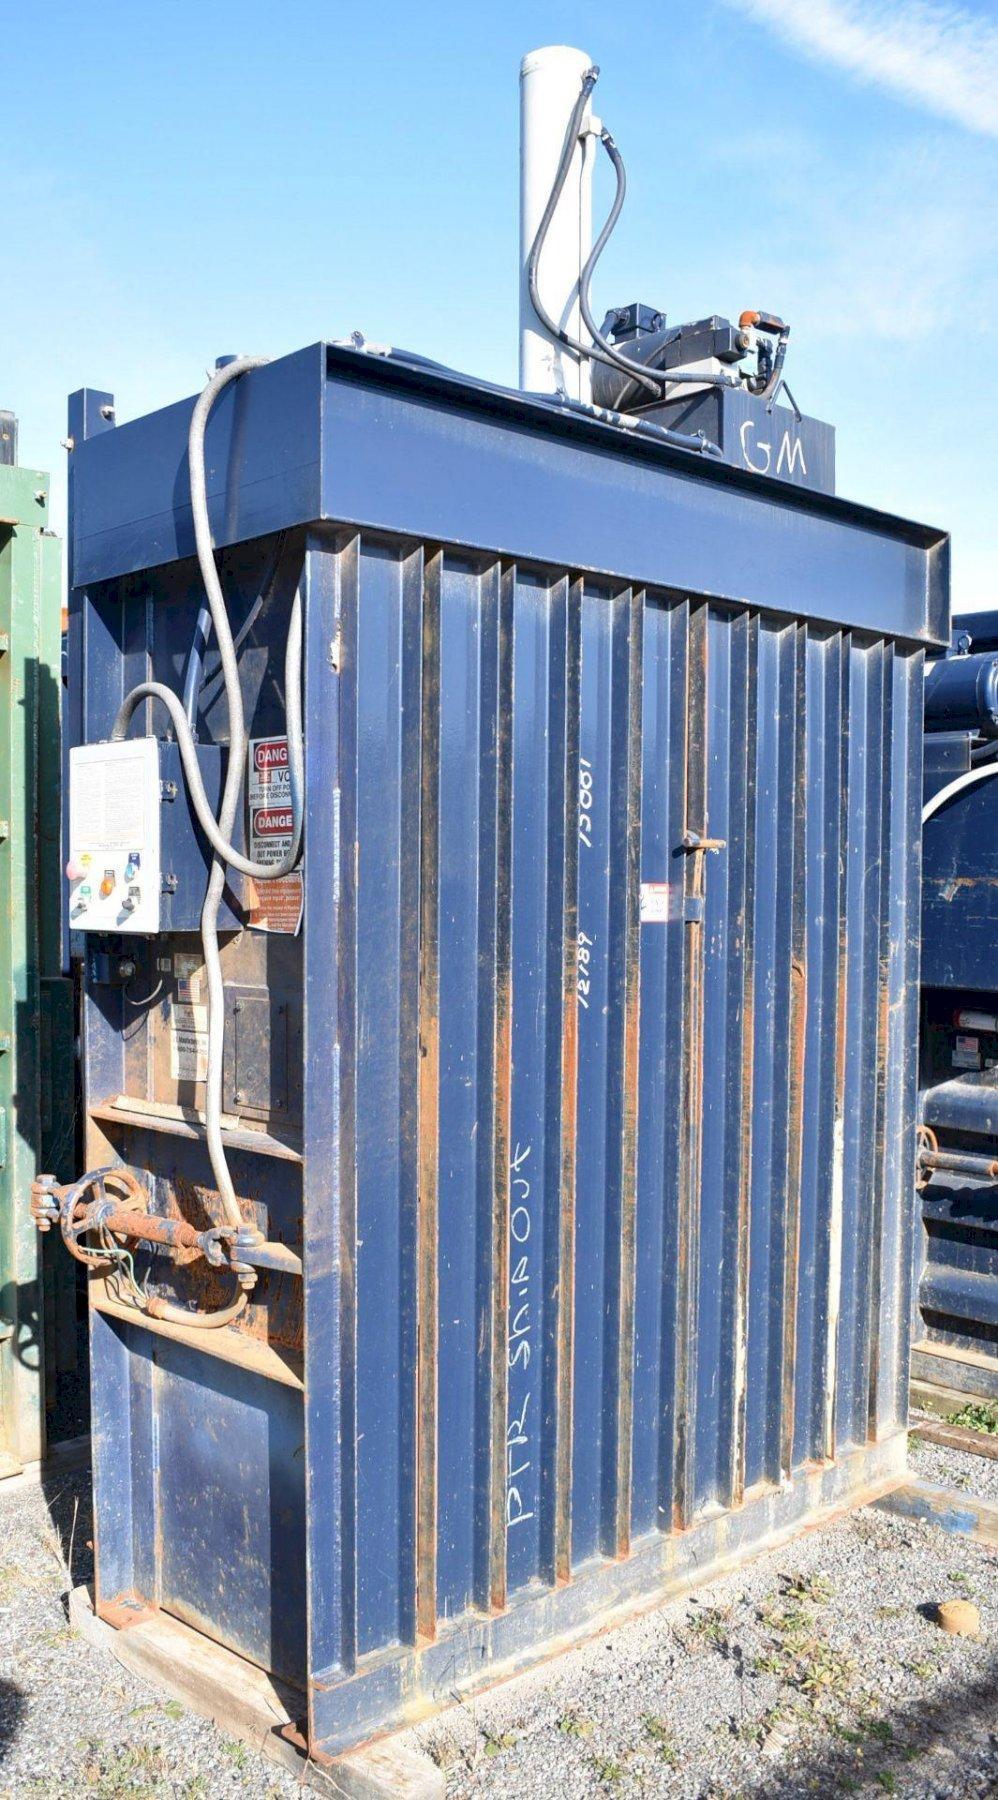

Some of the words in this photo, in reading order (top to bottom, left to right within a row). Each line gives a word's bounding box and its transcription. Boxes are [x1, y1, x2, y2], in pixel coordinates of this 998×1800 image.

[740, 420, 807, 475] GM
[257, 747, 288, 763] DANG
[258, 785, 272, 793] TUN
[257, 815, 293, 829] DANGE
[577, 931, 594, 1009] 12189
[507, 1392, 534, 1527] PTR
